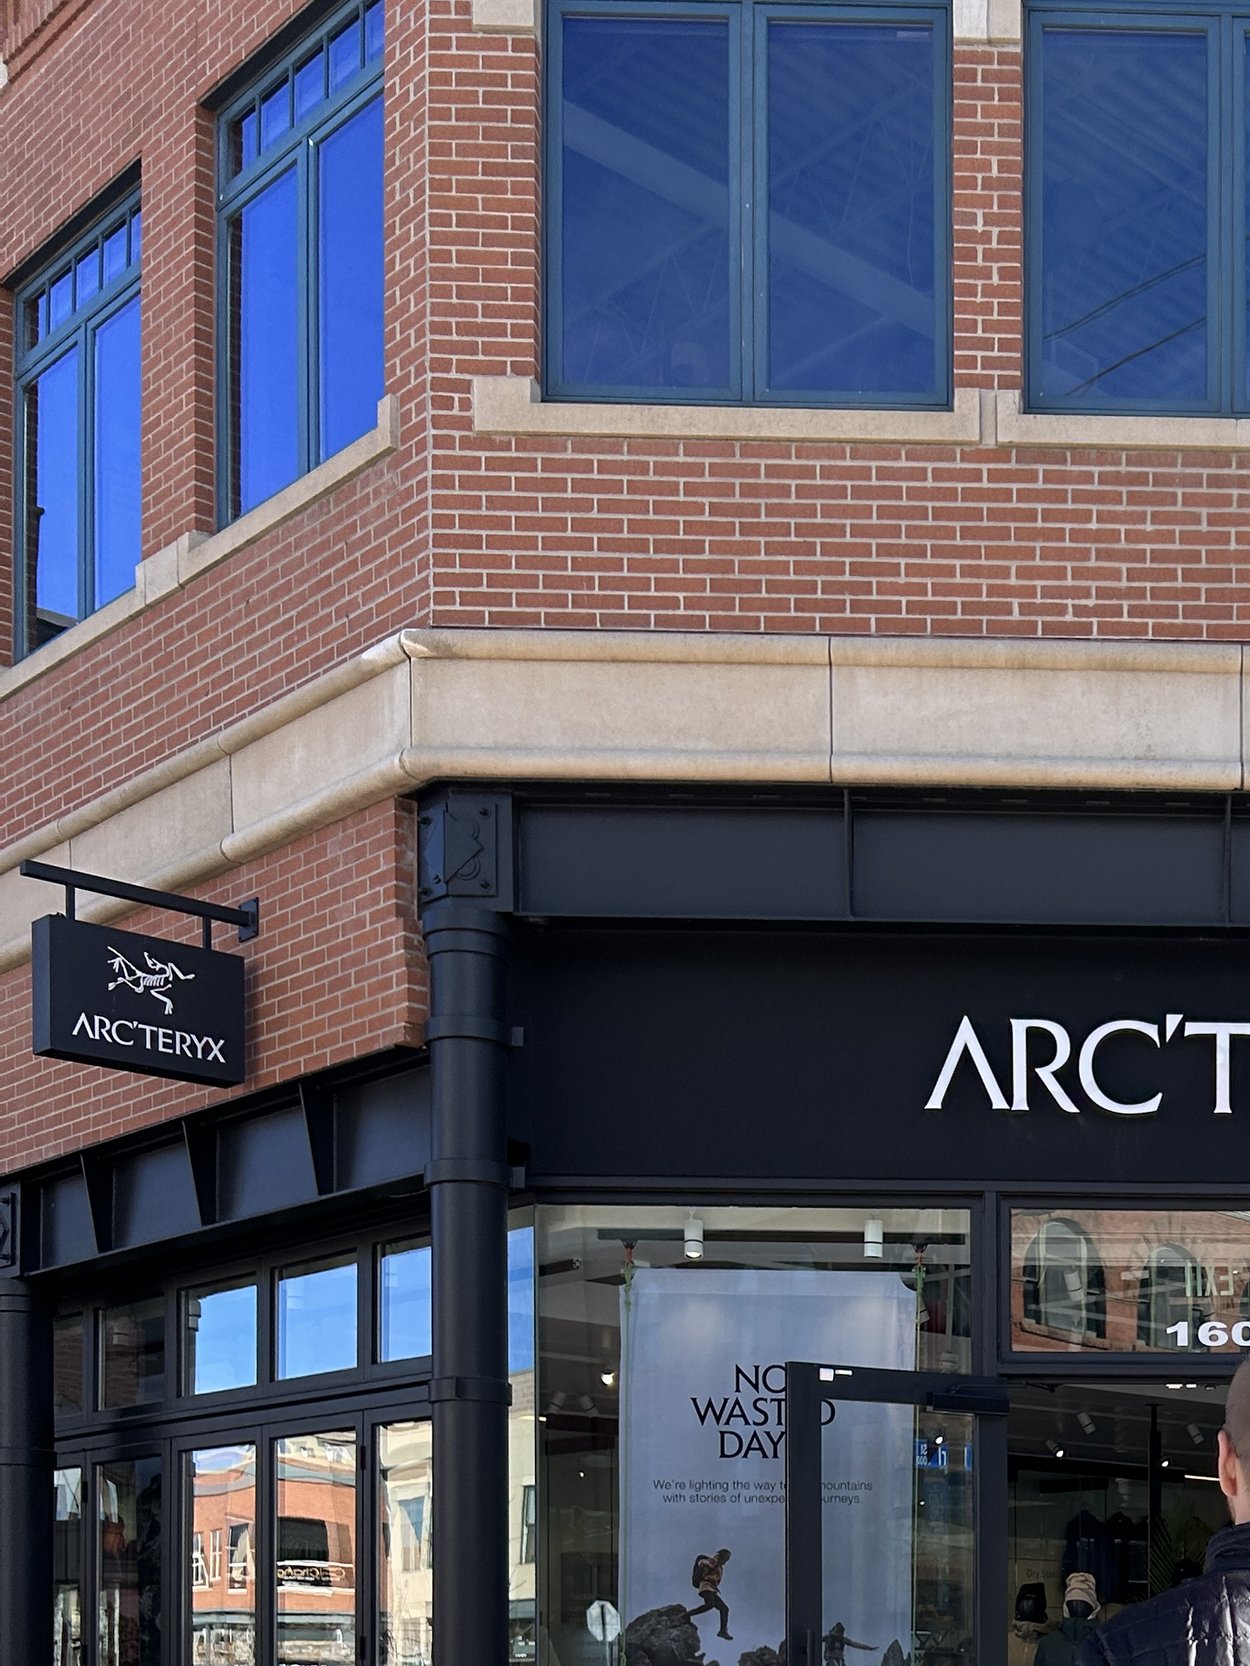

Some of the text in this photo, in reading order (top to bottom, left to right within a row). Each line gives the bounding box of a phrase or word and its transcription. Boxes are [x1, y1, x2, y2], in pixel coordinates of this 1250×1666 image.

[72, 1012, 227, 1063] ARC'TERYX
[690, 1397, 836, 1426] WASTD
[718, 1431, 786, 1459] DAY
[653, 1480, 686, 1491] We're
[689, 1480, 729, 1493] lighting
[732, 1480, 750, 1491] the
[753, 1482, 776, 1493] way
[663, 1493, 686, 1504] with
[689, 1493, 726, 1504] stories
[730, 1493, 741, 1504] of
[744, 1494, 785, 1506] unexpe
